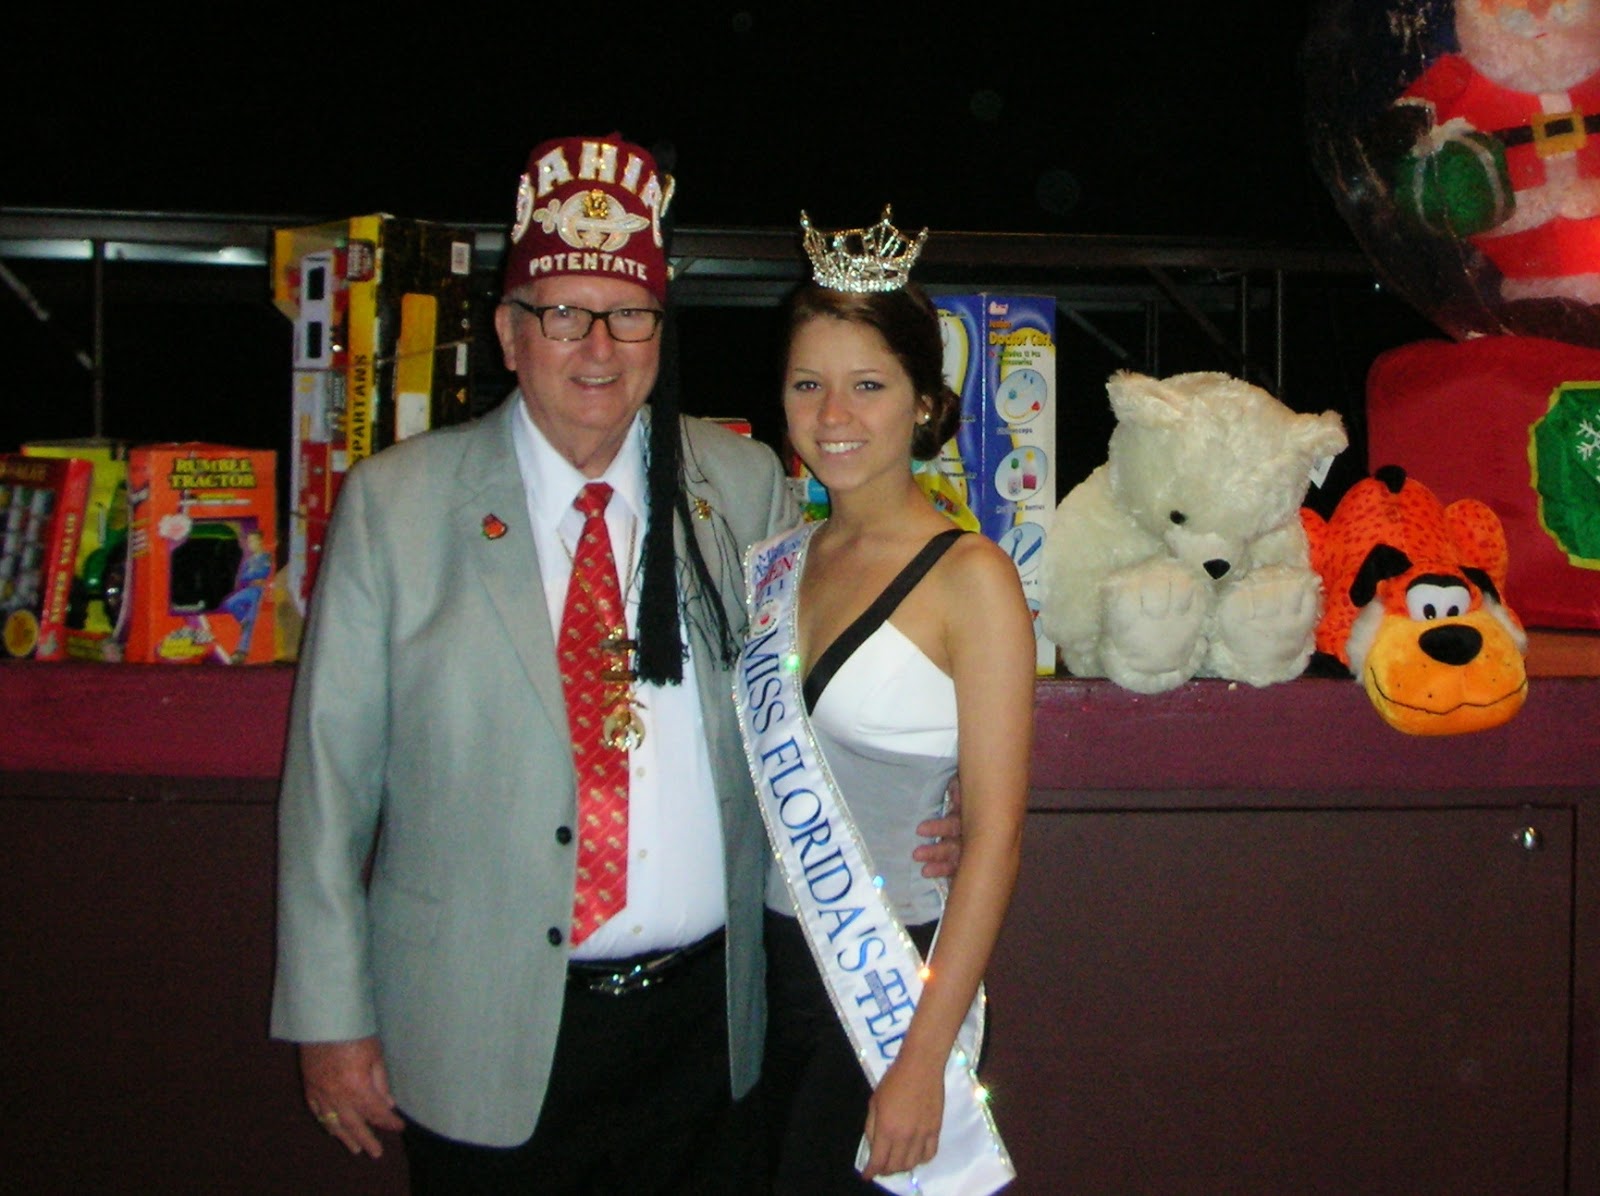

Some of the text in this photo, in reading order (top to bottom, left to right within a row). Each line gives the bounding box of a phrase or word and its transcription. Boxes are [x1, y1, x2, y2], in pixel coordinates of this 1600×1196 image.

[529, 252, 648, 281] POTENTATE
[170, 474, 256, 489] TRACTOR
[744, 629, 785, 735] MISS
[760, 736, 886, 972] FLORIDA'S
